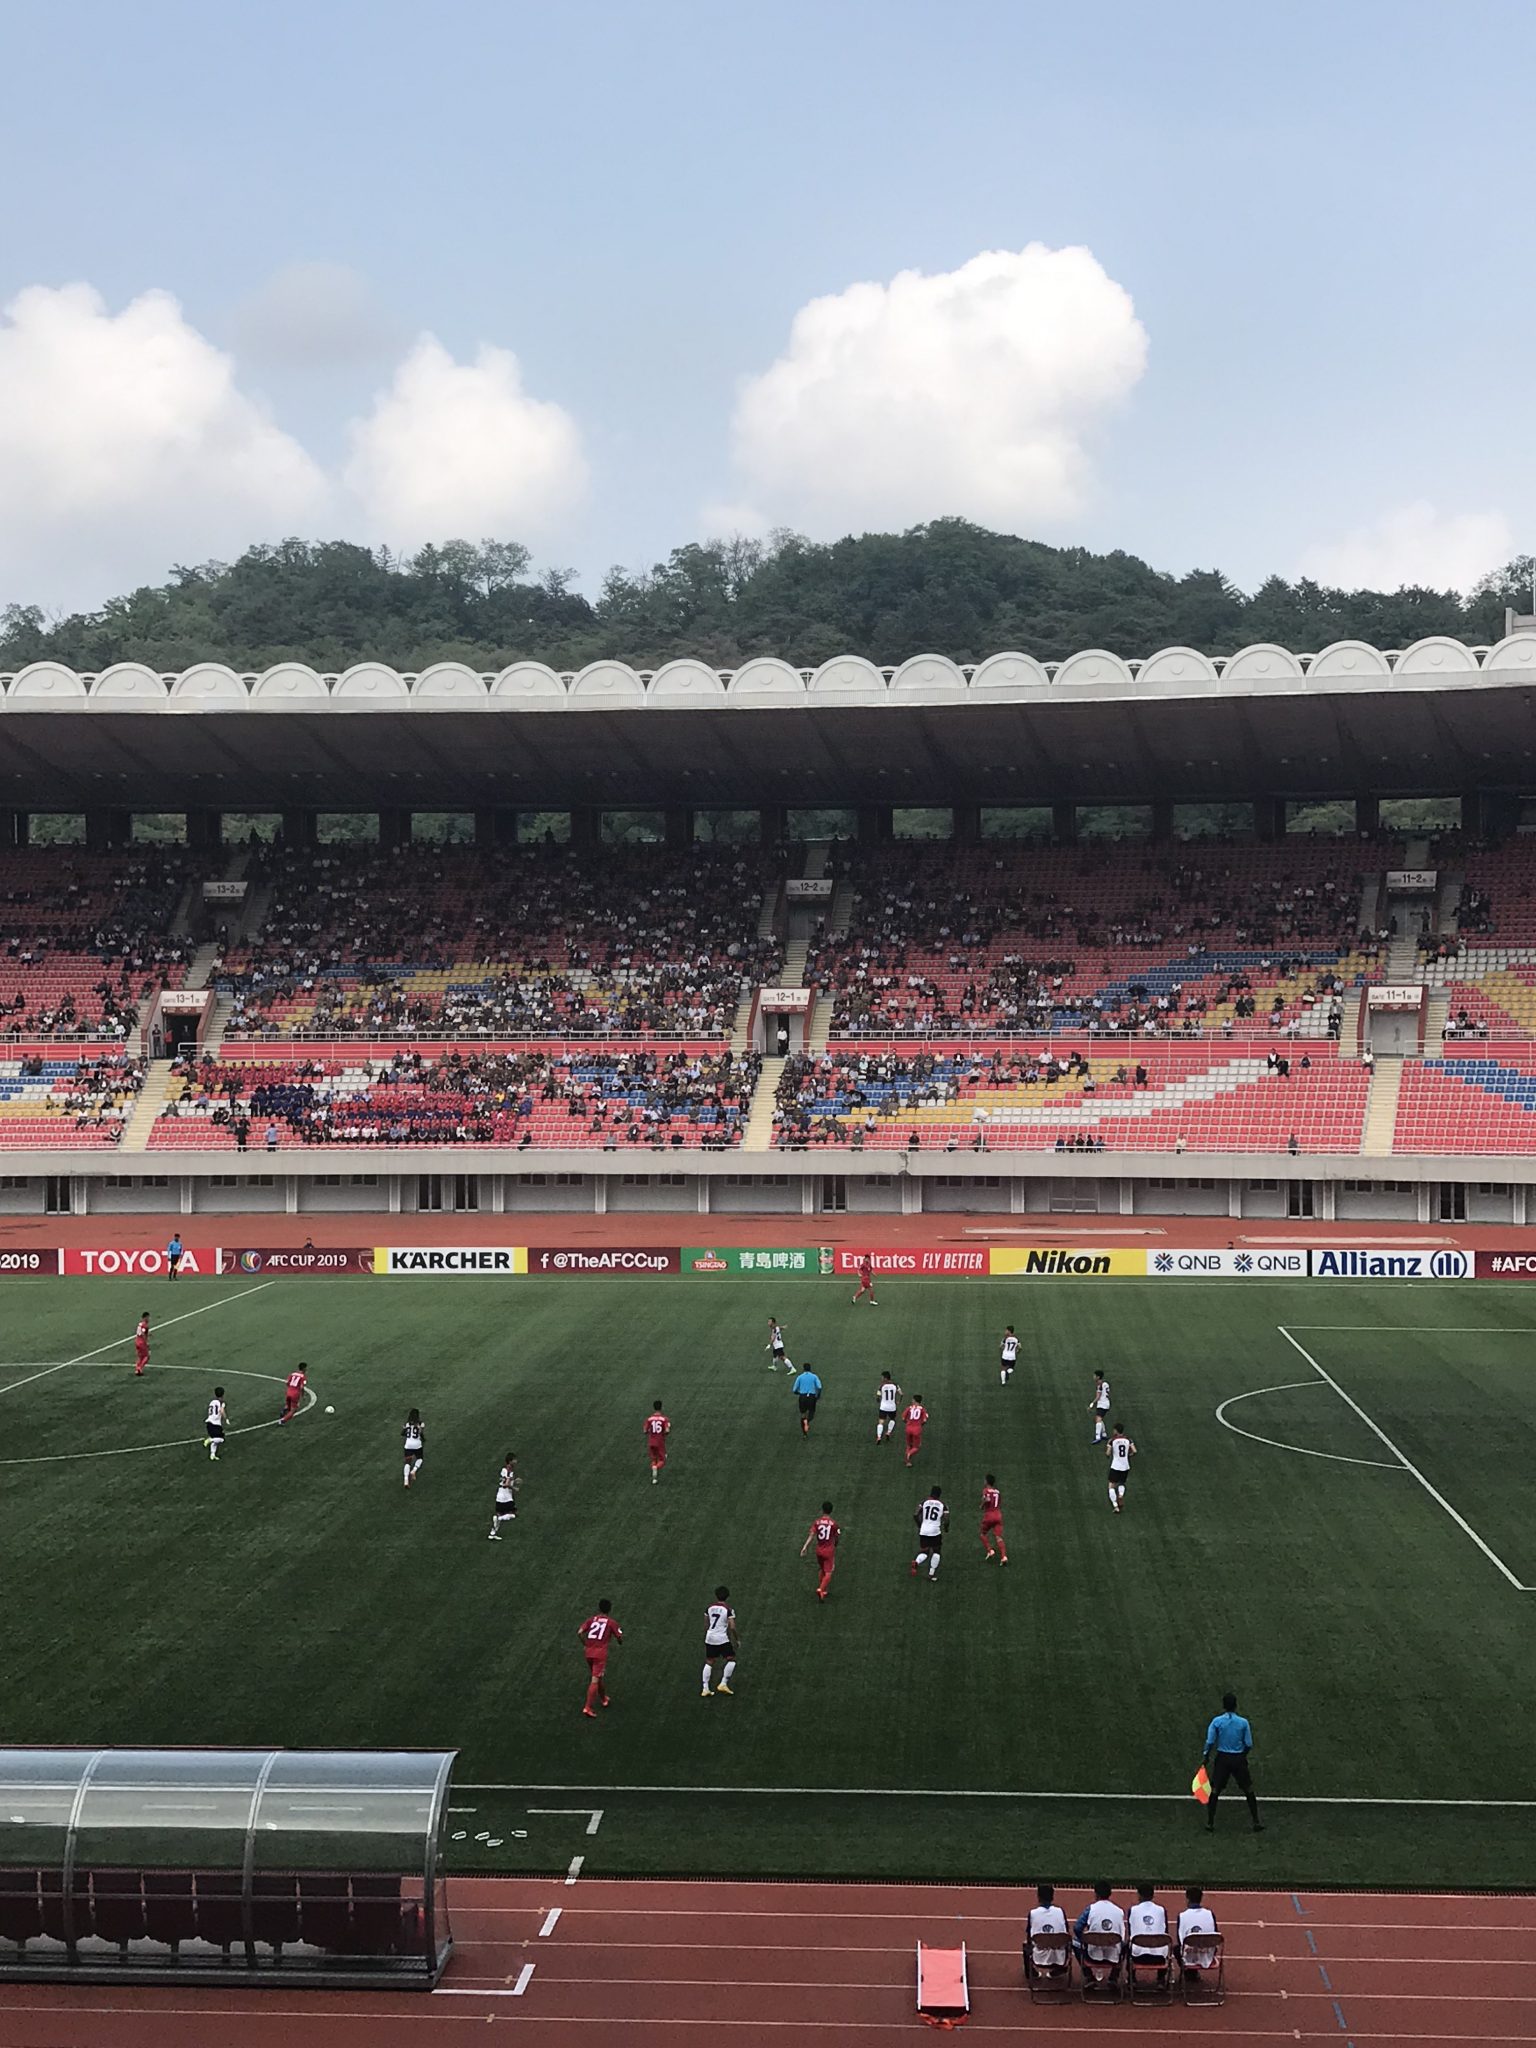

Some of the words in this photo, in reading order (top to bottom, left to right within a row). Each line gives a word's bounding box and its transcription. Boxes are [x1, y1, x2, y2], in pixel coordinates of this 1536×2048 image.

[1402, 874, 1422, 883] 11-2
[217, 885, 235, 894] 13-2
[800, 882, 818, 891] 12-2
[176, 994, 194, 1003] 13-1
[776, 992, 794, 1002] 12-1
[1386, 990, 1406, 1000] 11-1
[0, 1254, 40, 1269] 2019
[266, 1254, 288, 1267] AFC
[290, 1254, 315, 1267] CUP
[317, 1254, 347, 1267] 2019
[392, 1252, 510, 1269] KÄRCHER
[553, 1253, 669, 1271] @TheAFCCup
[922, 1253, 941, 1269] FLY
[944, 1253, 983, 1269] BETTER
[1026, 1250, 1111, 1274] Nikon
[1178, 1255, 1221, 1270] QNB
[1257, 1255, 1301, 1271] QNB
[1318, 1251, 1422, 1276] Allianz
[1007, 1341, 1016, 1351] 17
[884, 1389, 894, 1400] 11
[910, 1408, 921, 1420] 10
[651, 1420, 662, 1433] 16
[1118, 1444, 1126, 1457] 8
[925, 1505, 940, 1521] 16
[818, 1524, 831, 1540] 31
[711, 1613, 721, 1630] 7
